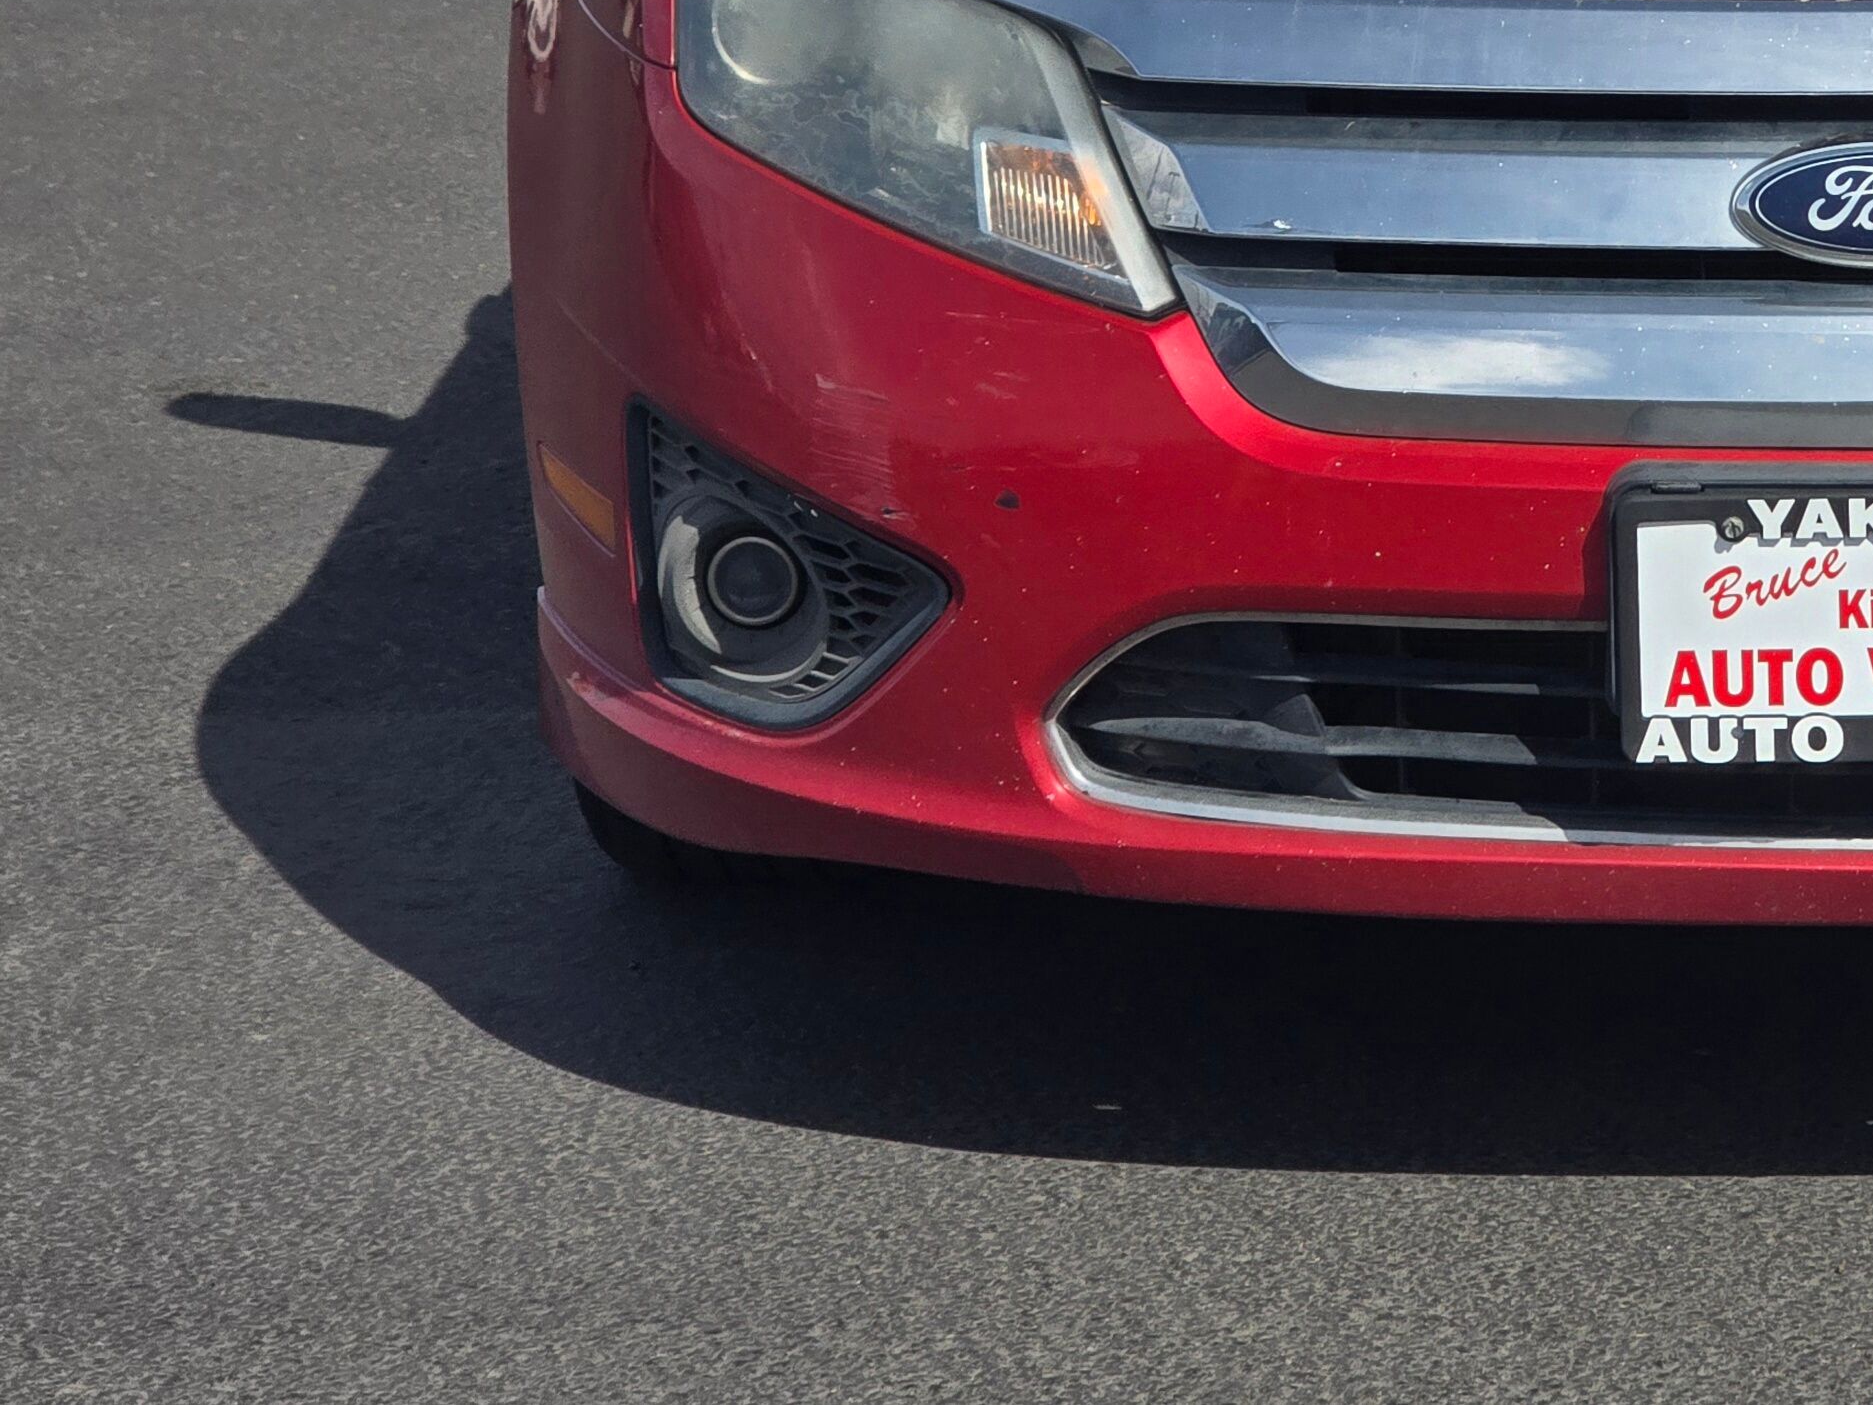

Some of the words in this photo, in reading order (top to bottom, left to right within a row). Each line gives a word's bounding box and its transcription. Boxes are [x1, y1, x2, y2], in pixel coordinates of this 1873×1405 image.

[1703, 549, 1847, 620] Bruce
[1664, 648, 1845, 708] AUTO
[1636, 715, 1844, 763] AUTO
